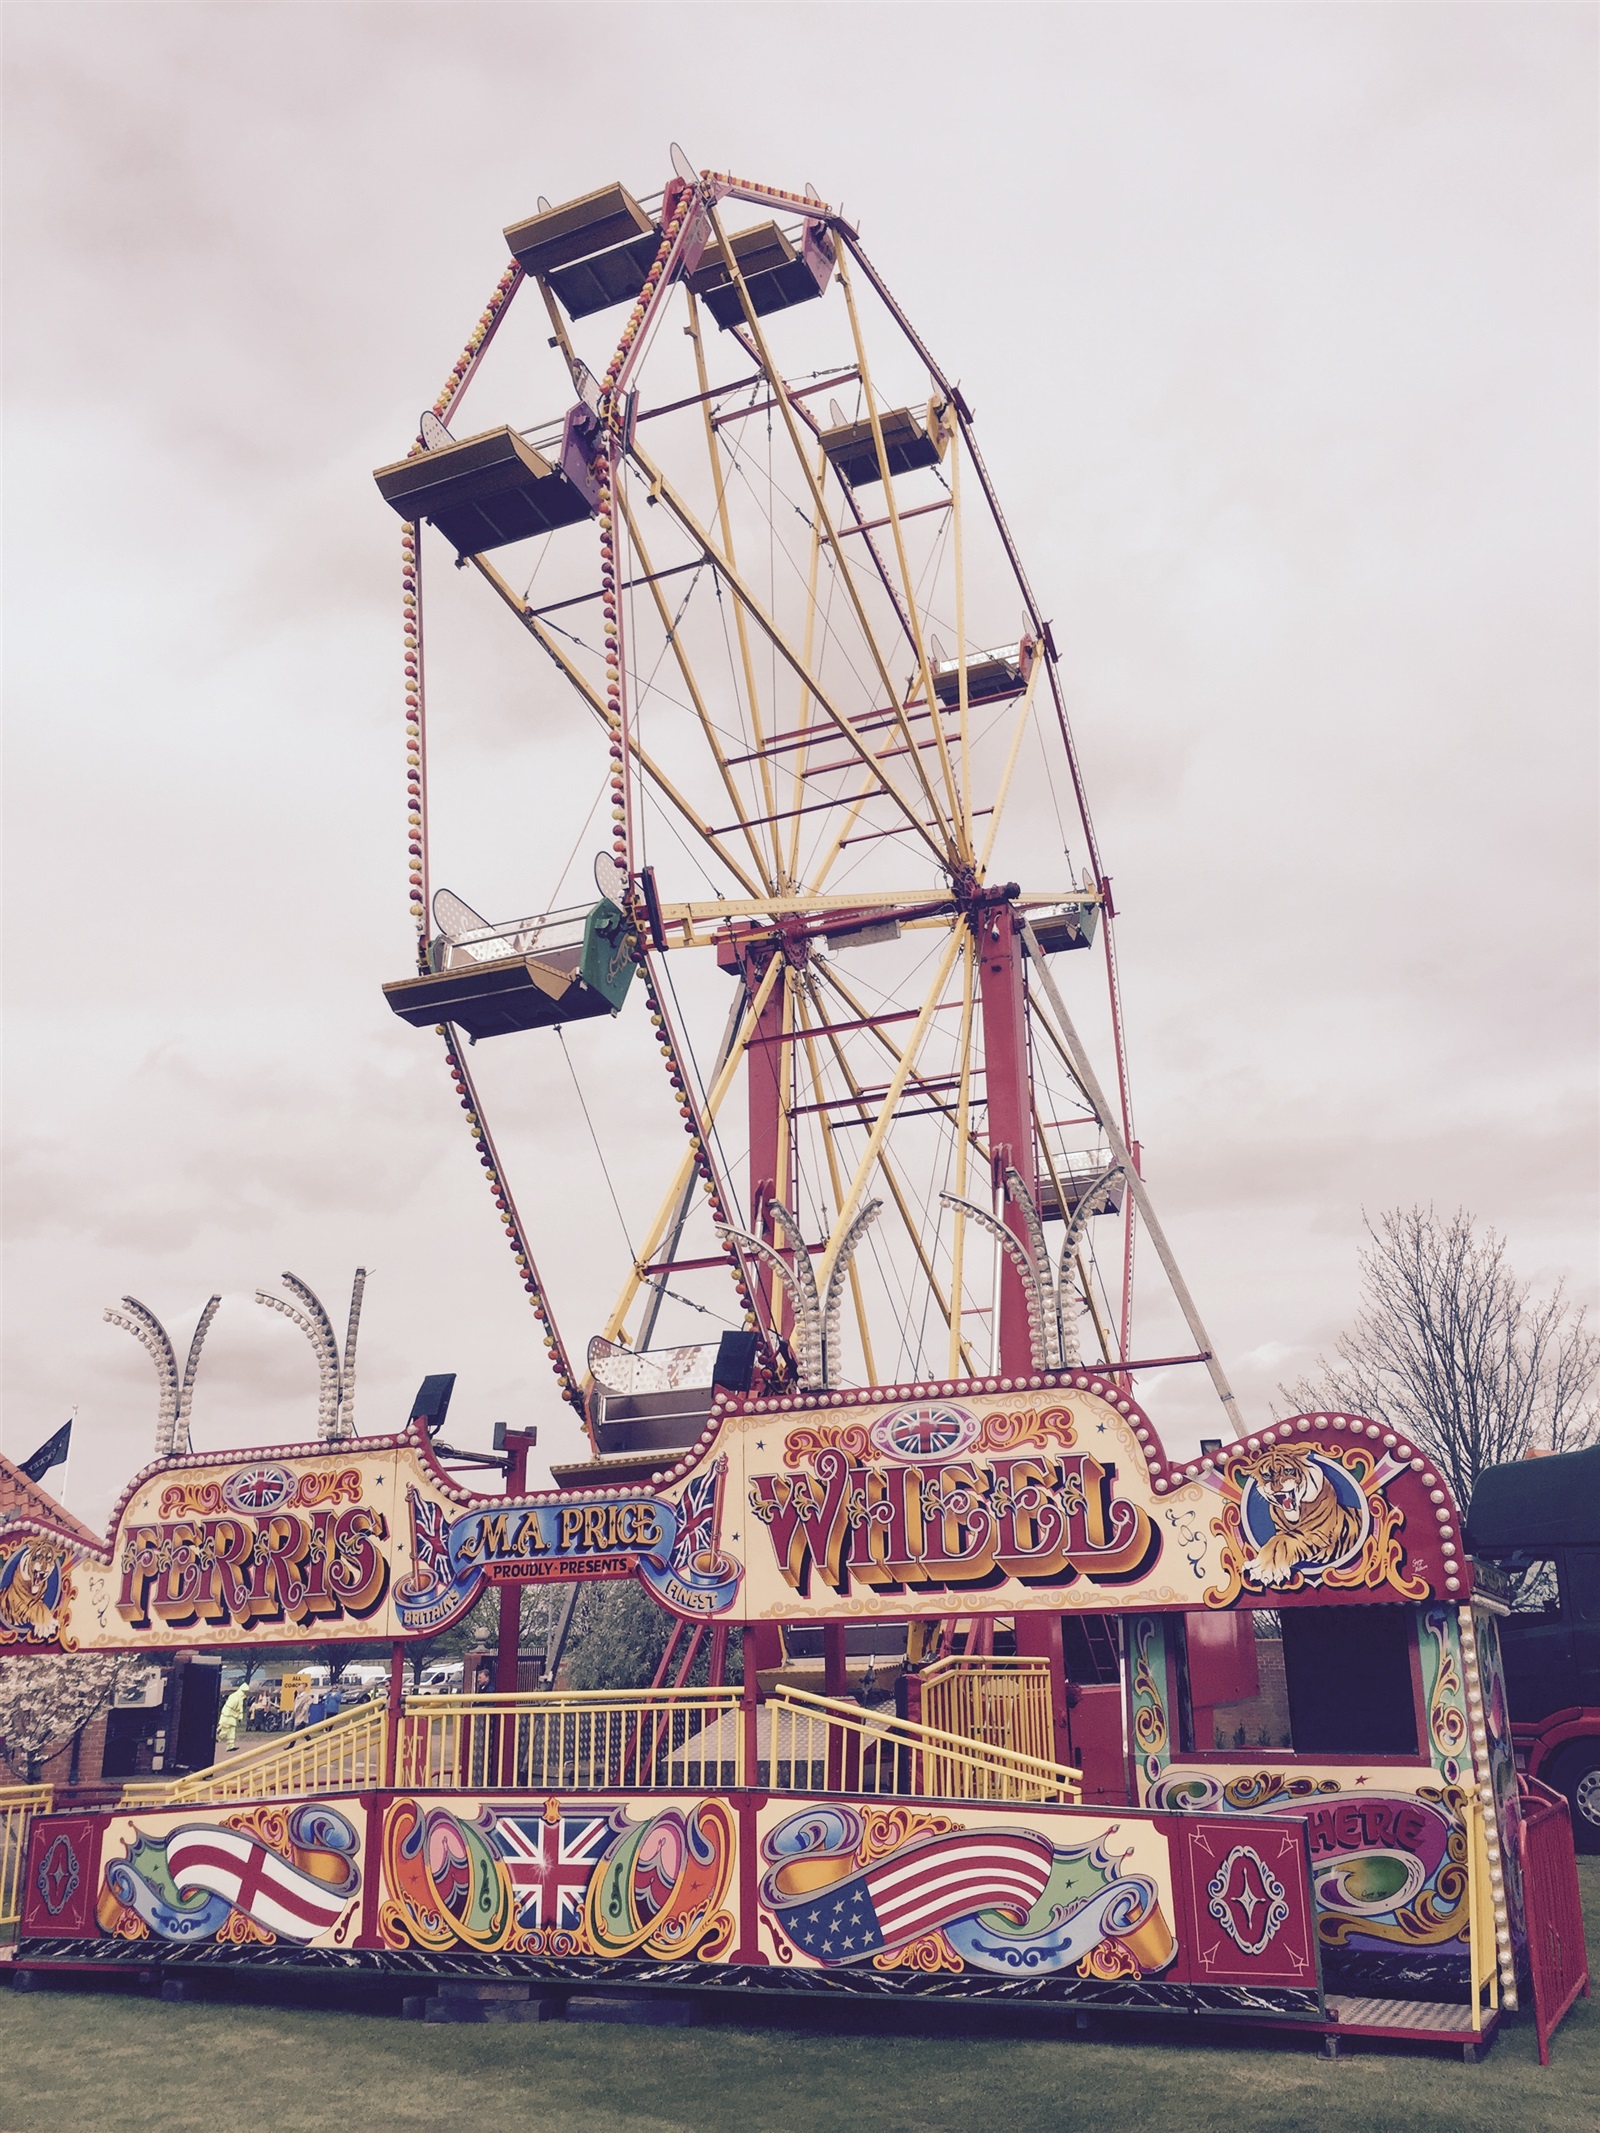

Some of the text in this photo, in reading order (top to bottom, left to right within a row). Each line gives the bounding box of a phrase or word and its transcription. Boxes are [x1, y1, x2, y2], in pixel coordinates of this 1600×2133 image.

[458, 1504, 662, 1558] M.A. PRICE
[749, 1449, 1155, 1592] WHEEL
[115, 1506, 388, 1628] FERRIS
[493, 1557, 627, 1578] PROUDLY PRESENTS
[665, 1579, 718, 1609] FINEST
[1306, 1804, 1426, 1853] HERE
